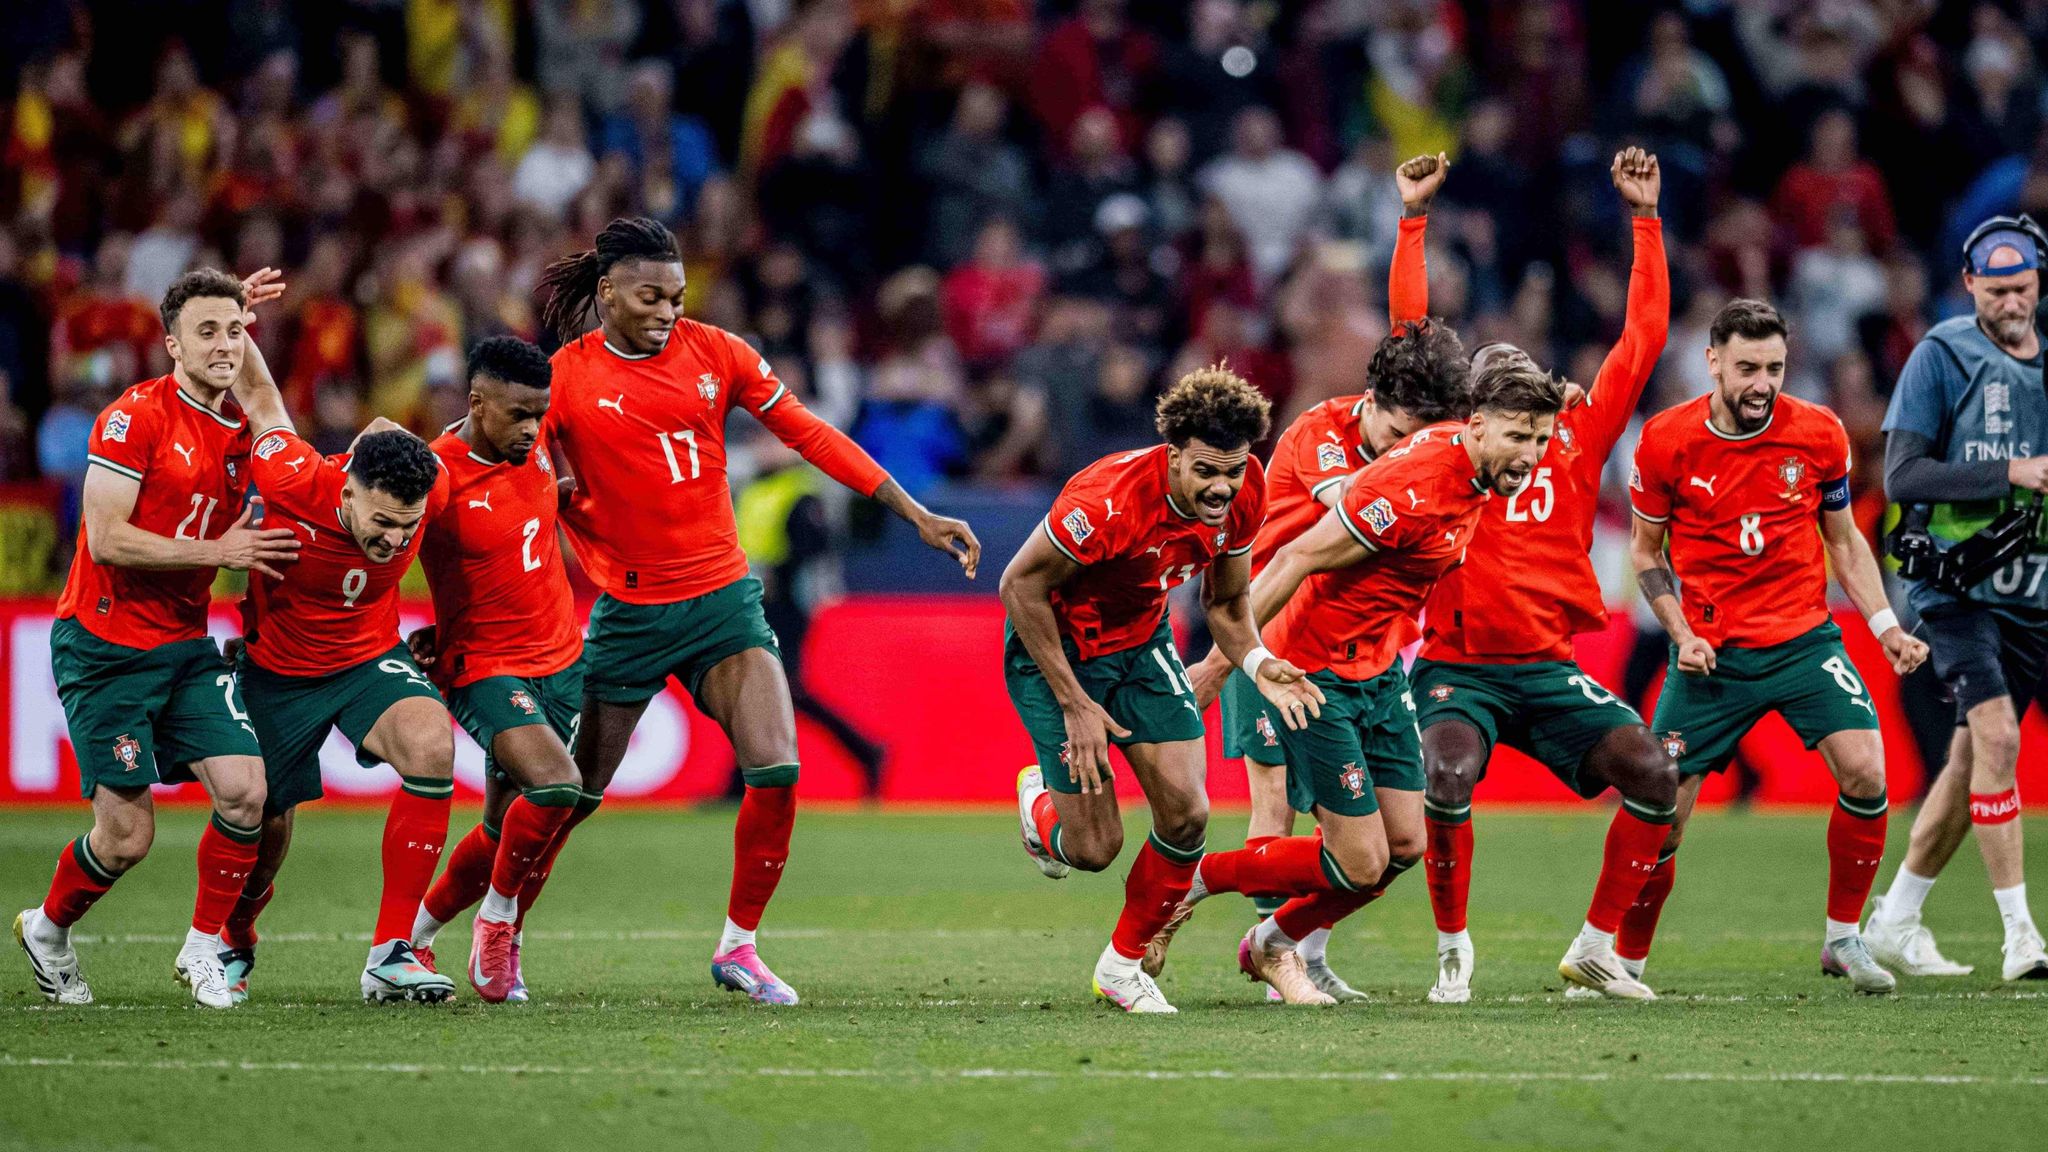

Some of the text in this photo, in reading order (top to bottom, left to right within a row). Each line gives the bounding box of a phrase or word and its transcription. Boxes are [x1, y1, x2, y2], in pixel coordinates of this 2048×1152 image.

[656, 429, 700, 485] 17
[1965, 441, 2031, 461] FINALS
[174, 493, 218, 540] 21
[1505, 467, 1555, 522] 25
[522, 517, 541, 573] 2
[1739, 513, 1764, 557] 8
[342, 569, 367, 607] 9
[1822, 656, 1862, 695] 8
